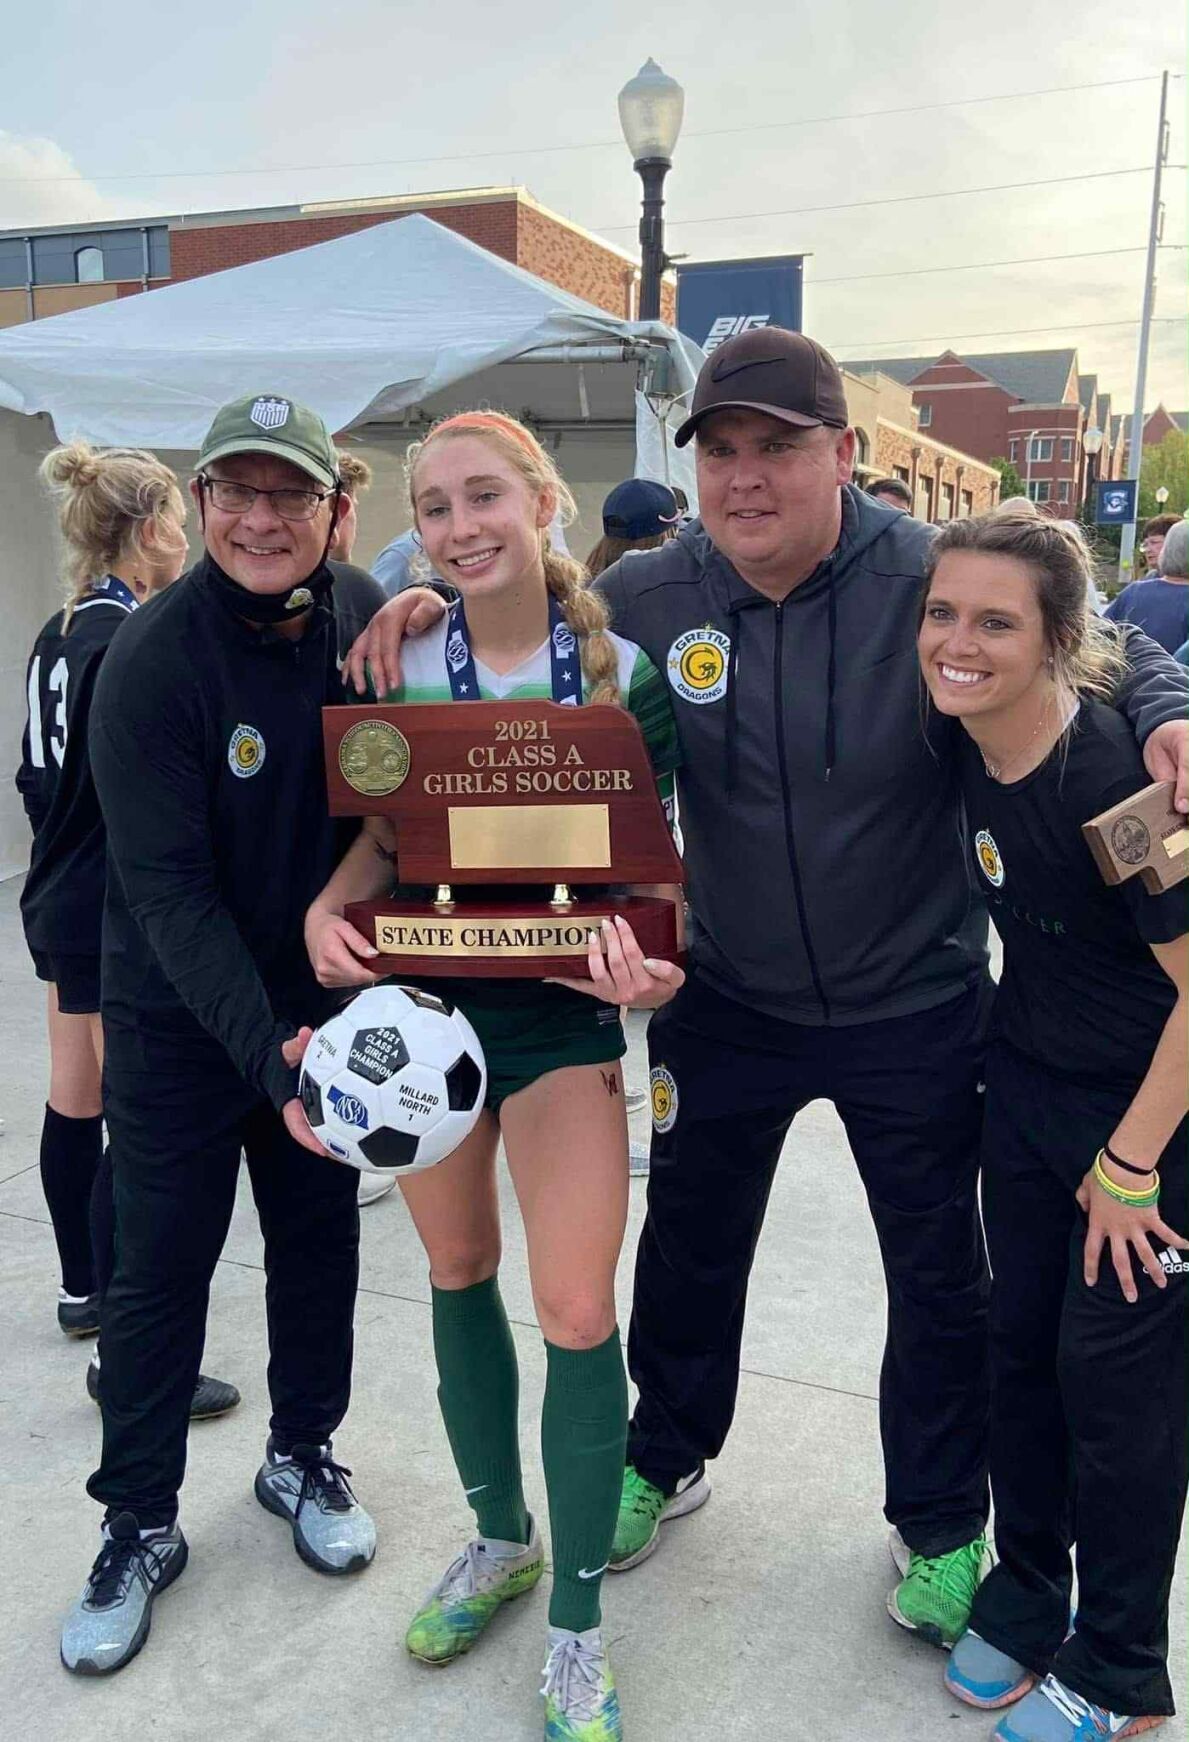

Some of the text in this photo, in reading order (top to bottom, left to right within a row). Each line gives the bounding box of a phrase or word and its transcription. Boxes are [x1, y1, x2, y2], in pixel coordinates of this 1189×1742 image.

[708, 315, 770, 337] BIG
[675, 631, 731, 655] GRETNA
[677, 683, 722, 700] DRAGONS
[28, 655, 69, 770] 13
[494, 720, 551, 741] 2021
[467, 744, 584, 768] CLASS A
[423, 769, 633, 794] GIRLS SOCCER
[382, 926, 453, 946] STATE
[365, 1034, 399, 1058] CLASS A
[377, 1028, 401, 1045] 2021
[350, 1049, 394, 1078] CHAMPION
[364, 1045, 389, 1063] GIRLS
[399, 1084, 439, 1105] MILLARD
[399, 1097, 431, 1115] NORTH
[1143, 1261, 1189, 1274] das
